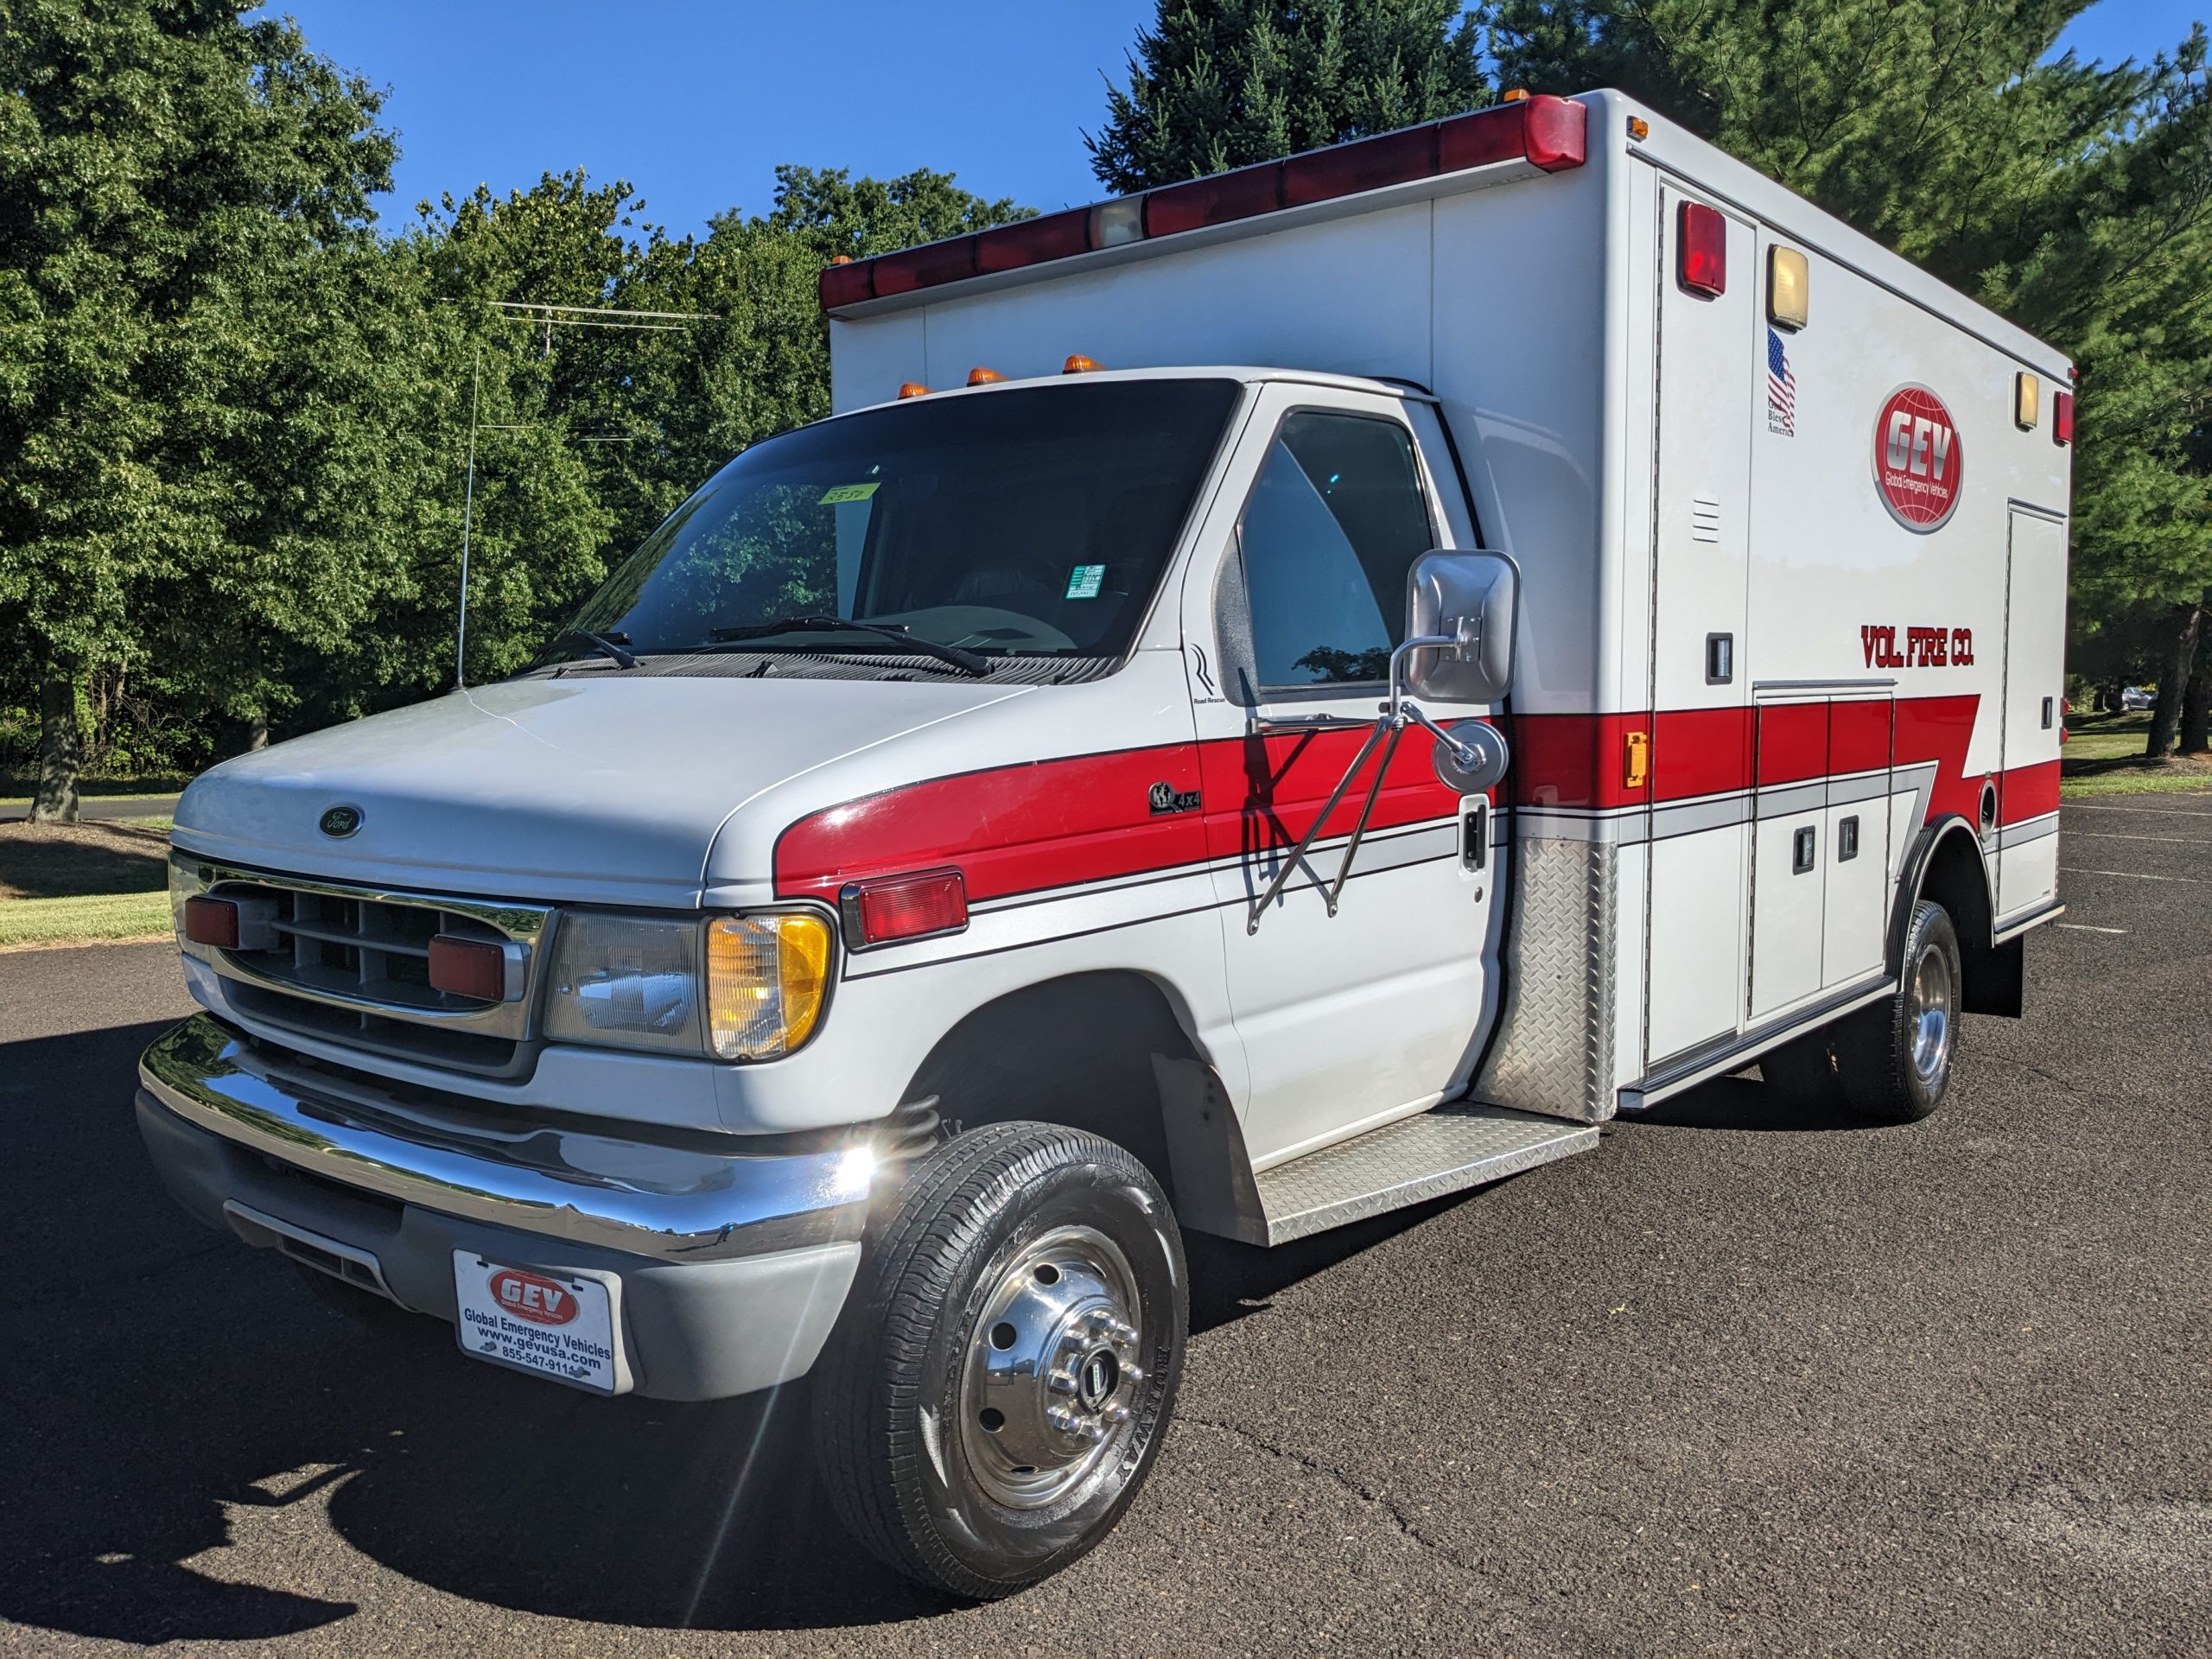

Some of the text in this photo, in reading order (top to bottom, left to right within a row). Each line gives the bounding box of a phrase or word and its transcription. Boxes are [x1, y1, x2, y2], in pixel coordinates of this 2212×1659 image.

[1886, 410, 1951, 481] GEV
[1885, 471, 1948, 499] Global Emergency Vehicles
[1906, 626, 1948, 668] FIRE
[1950, 627, 1974, 667] CO.
[1178, 791, 1200, 807] 4x4
[327, 810, 353, 830] Ford
[500, 1299, 517, 1308] Global
[517, 1303, 543, 1316] Emergency
[501, 1278, 563, 1313] GEV
[464, 1307, 611, 1360] Global Emergency Vehicles
[477, 1326, 601, 1370] www.gevusa.com
[1116, 1345, 1171, 1487] RUNWAY
